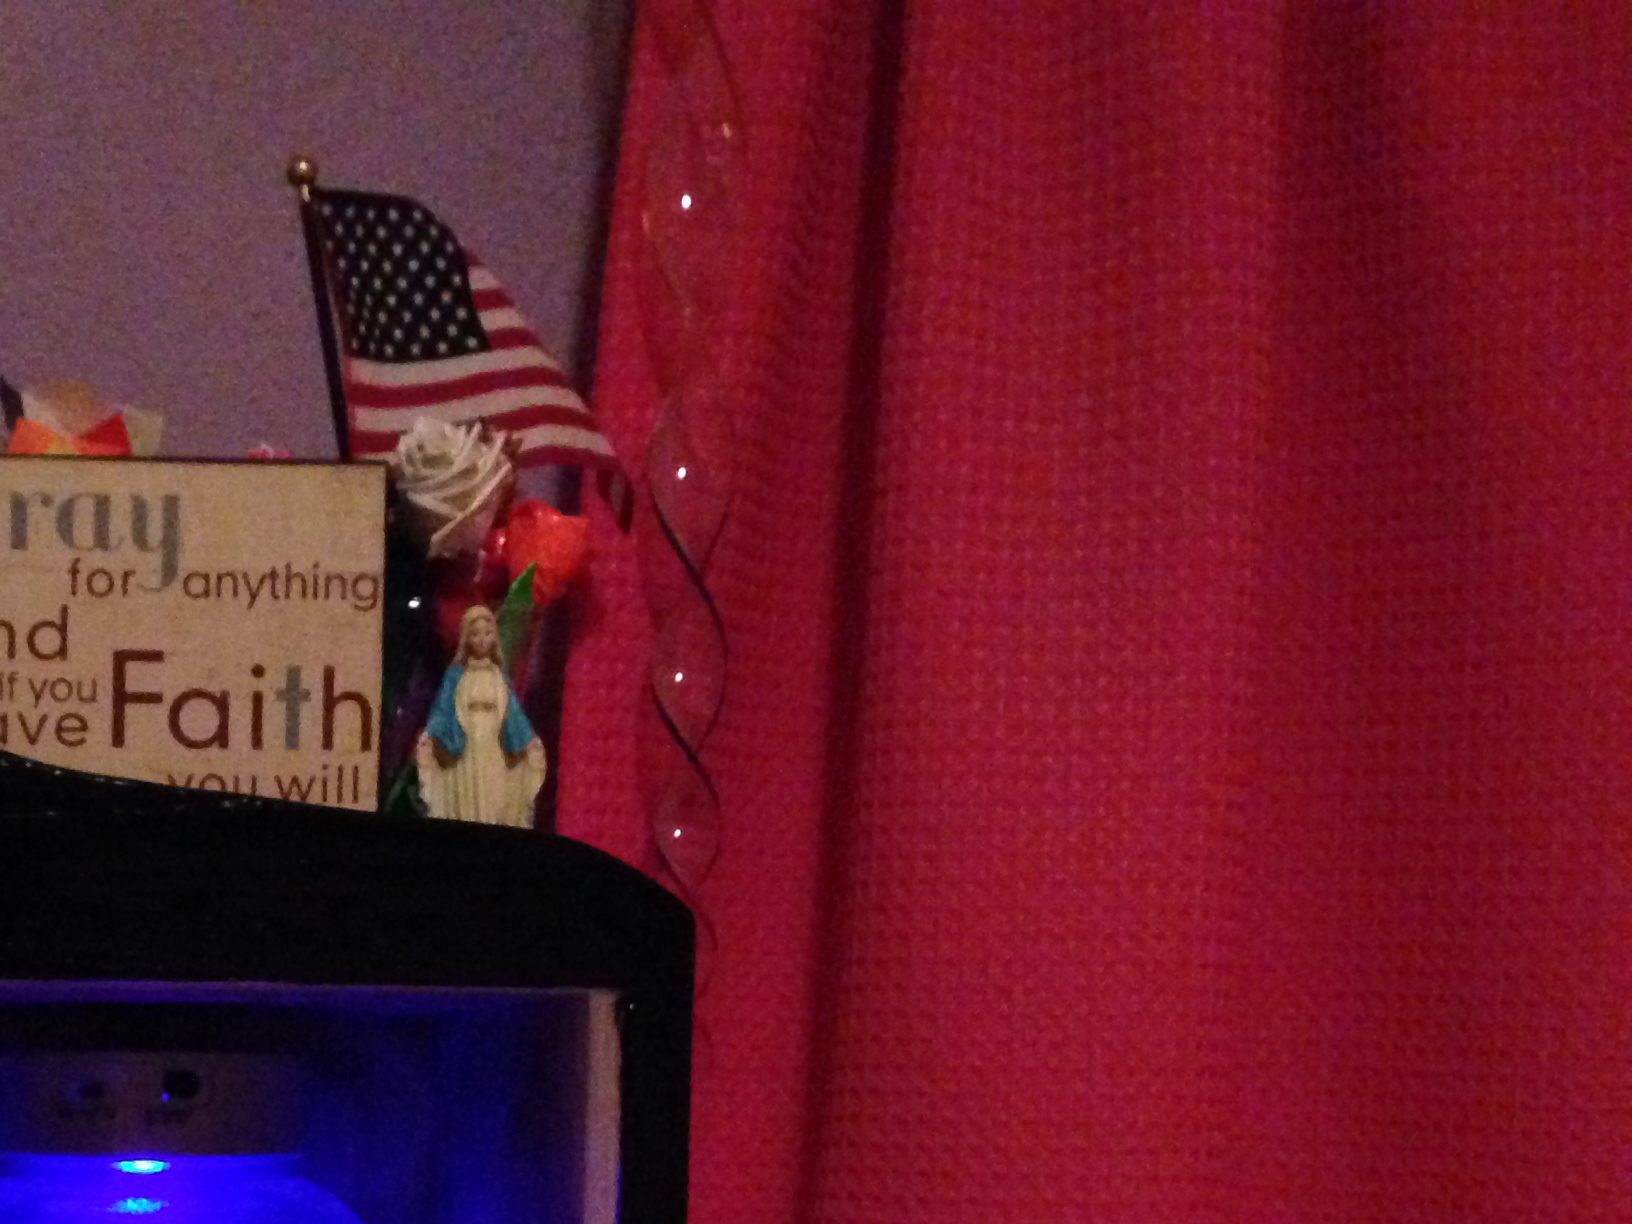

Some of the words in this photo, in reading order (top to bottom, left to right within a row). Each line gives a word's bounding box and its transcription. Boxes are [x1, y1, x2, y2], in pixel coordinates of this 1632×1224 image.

[69, 557, 135, 599] for
[183, 562, 379, 612] anything
[27, 676, 98, 709] you
[112, 649, 373, 751] Faith
[274, 763, 358, 804] will
